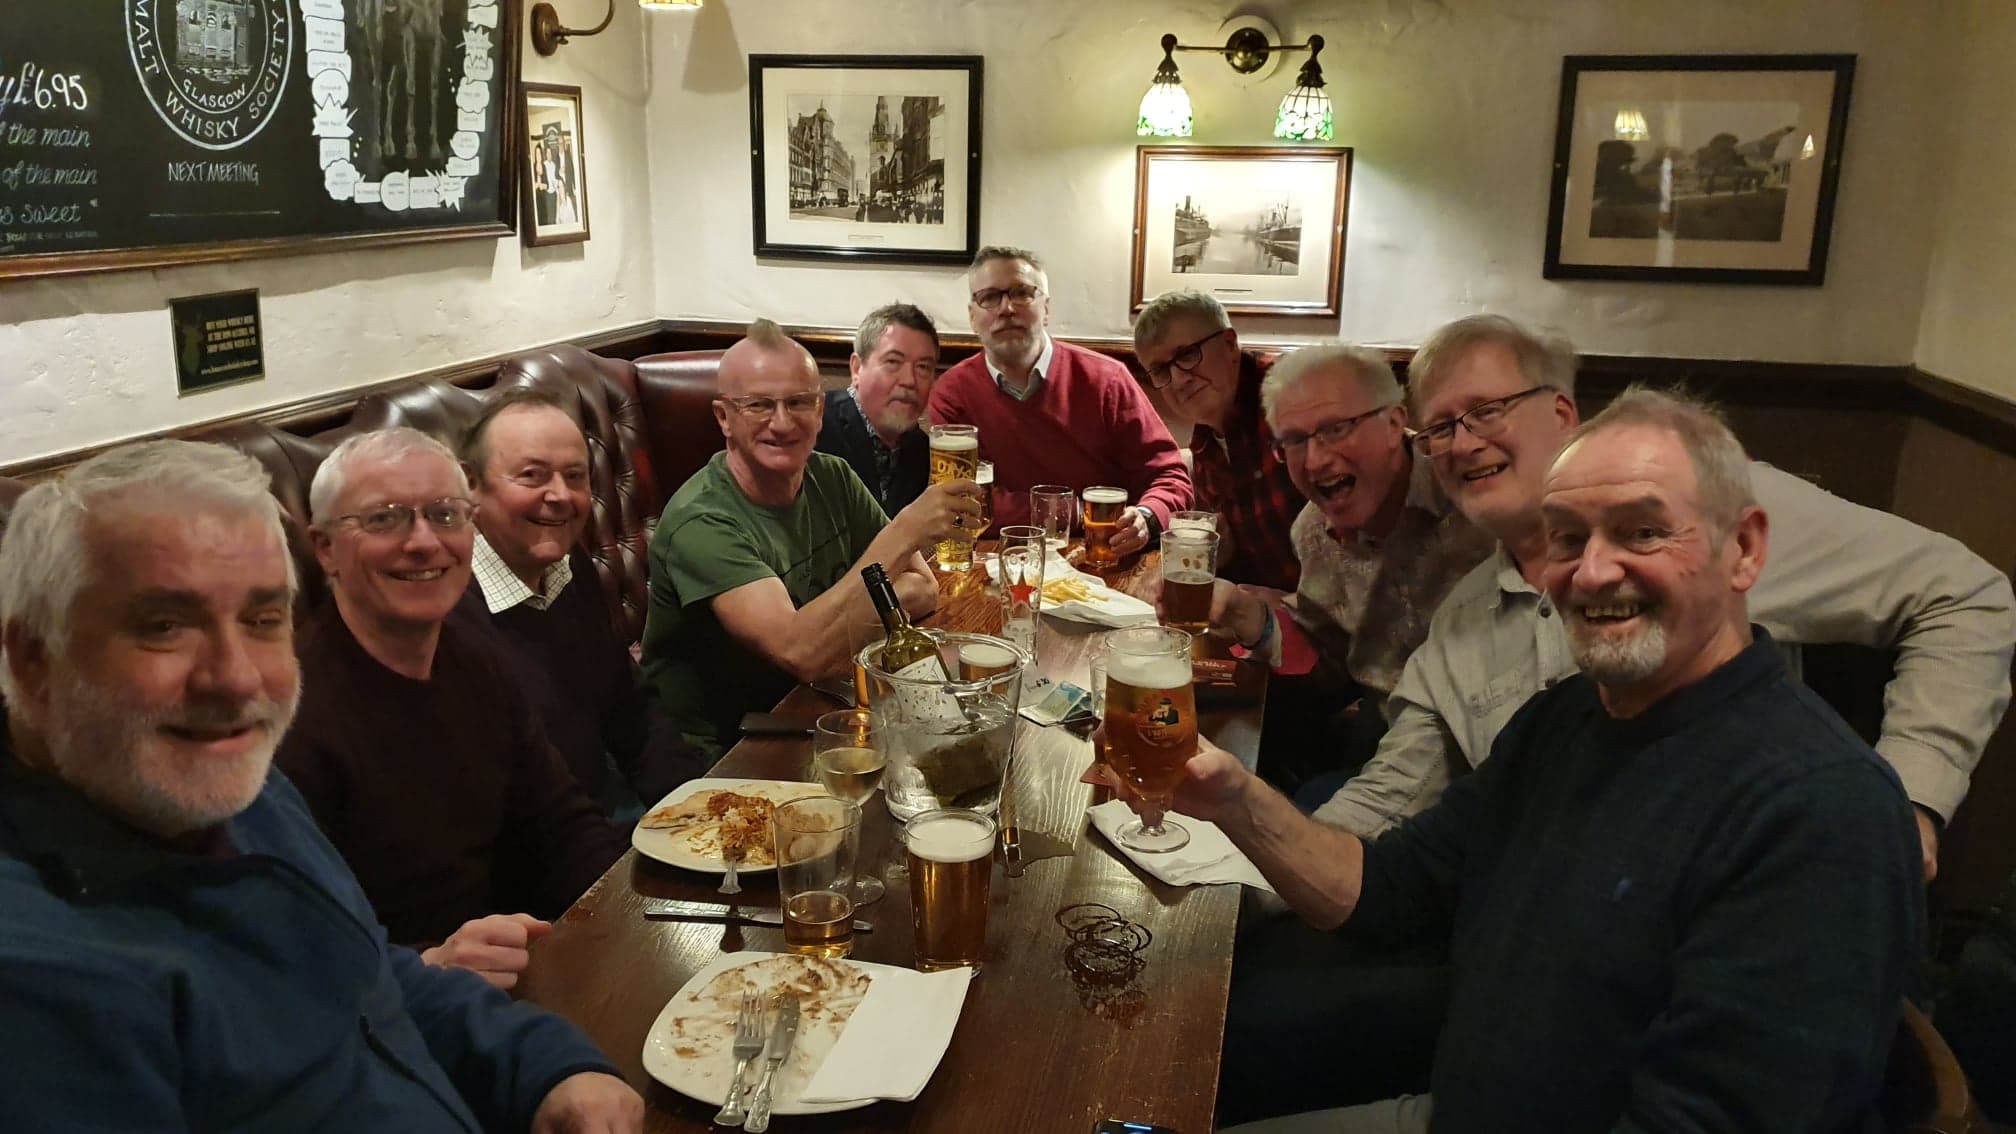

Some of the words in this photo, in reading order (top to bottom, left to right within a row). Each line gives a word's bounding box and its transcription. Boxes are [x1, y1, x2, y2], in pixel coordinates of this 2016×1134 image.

[135, 0, 160, 74] MALT
[166, 90, 240, 139] WHISKY
[249, 9, 284, 119] SOCIETY
[13, 62, 88, 110] £6.95
[183, 79, 246, 109] GLASGOW
[8, 123, 37, 145] the
[2, 160, 25, 191] of
[26, 163, 51, 185] the
[53, 163, 97, 185] main
[168, 161, 207, 182] NEXT
[207, 160, 259, 186] MEETING
